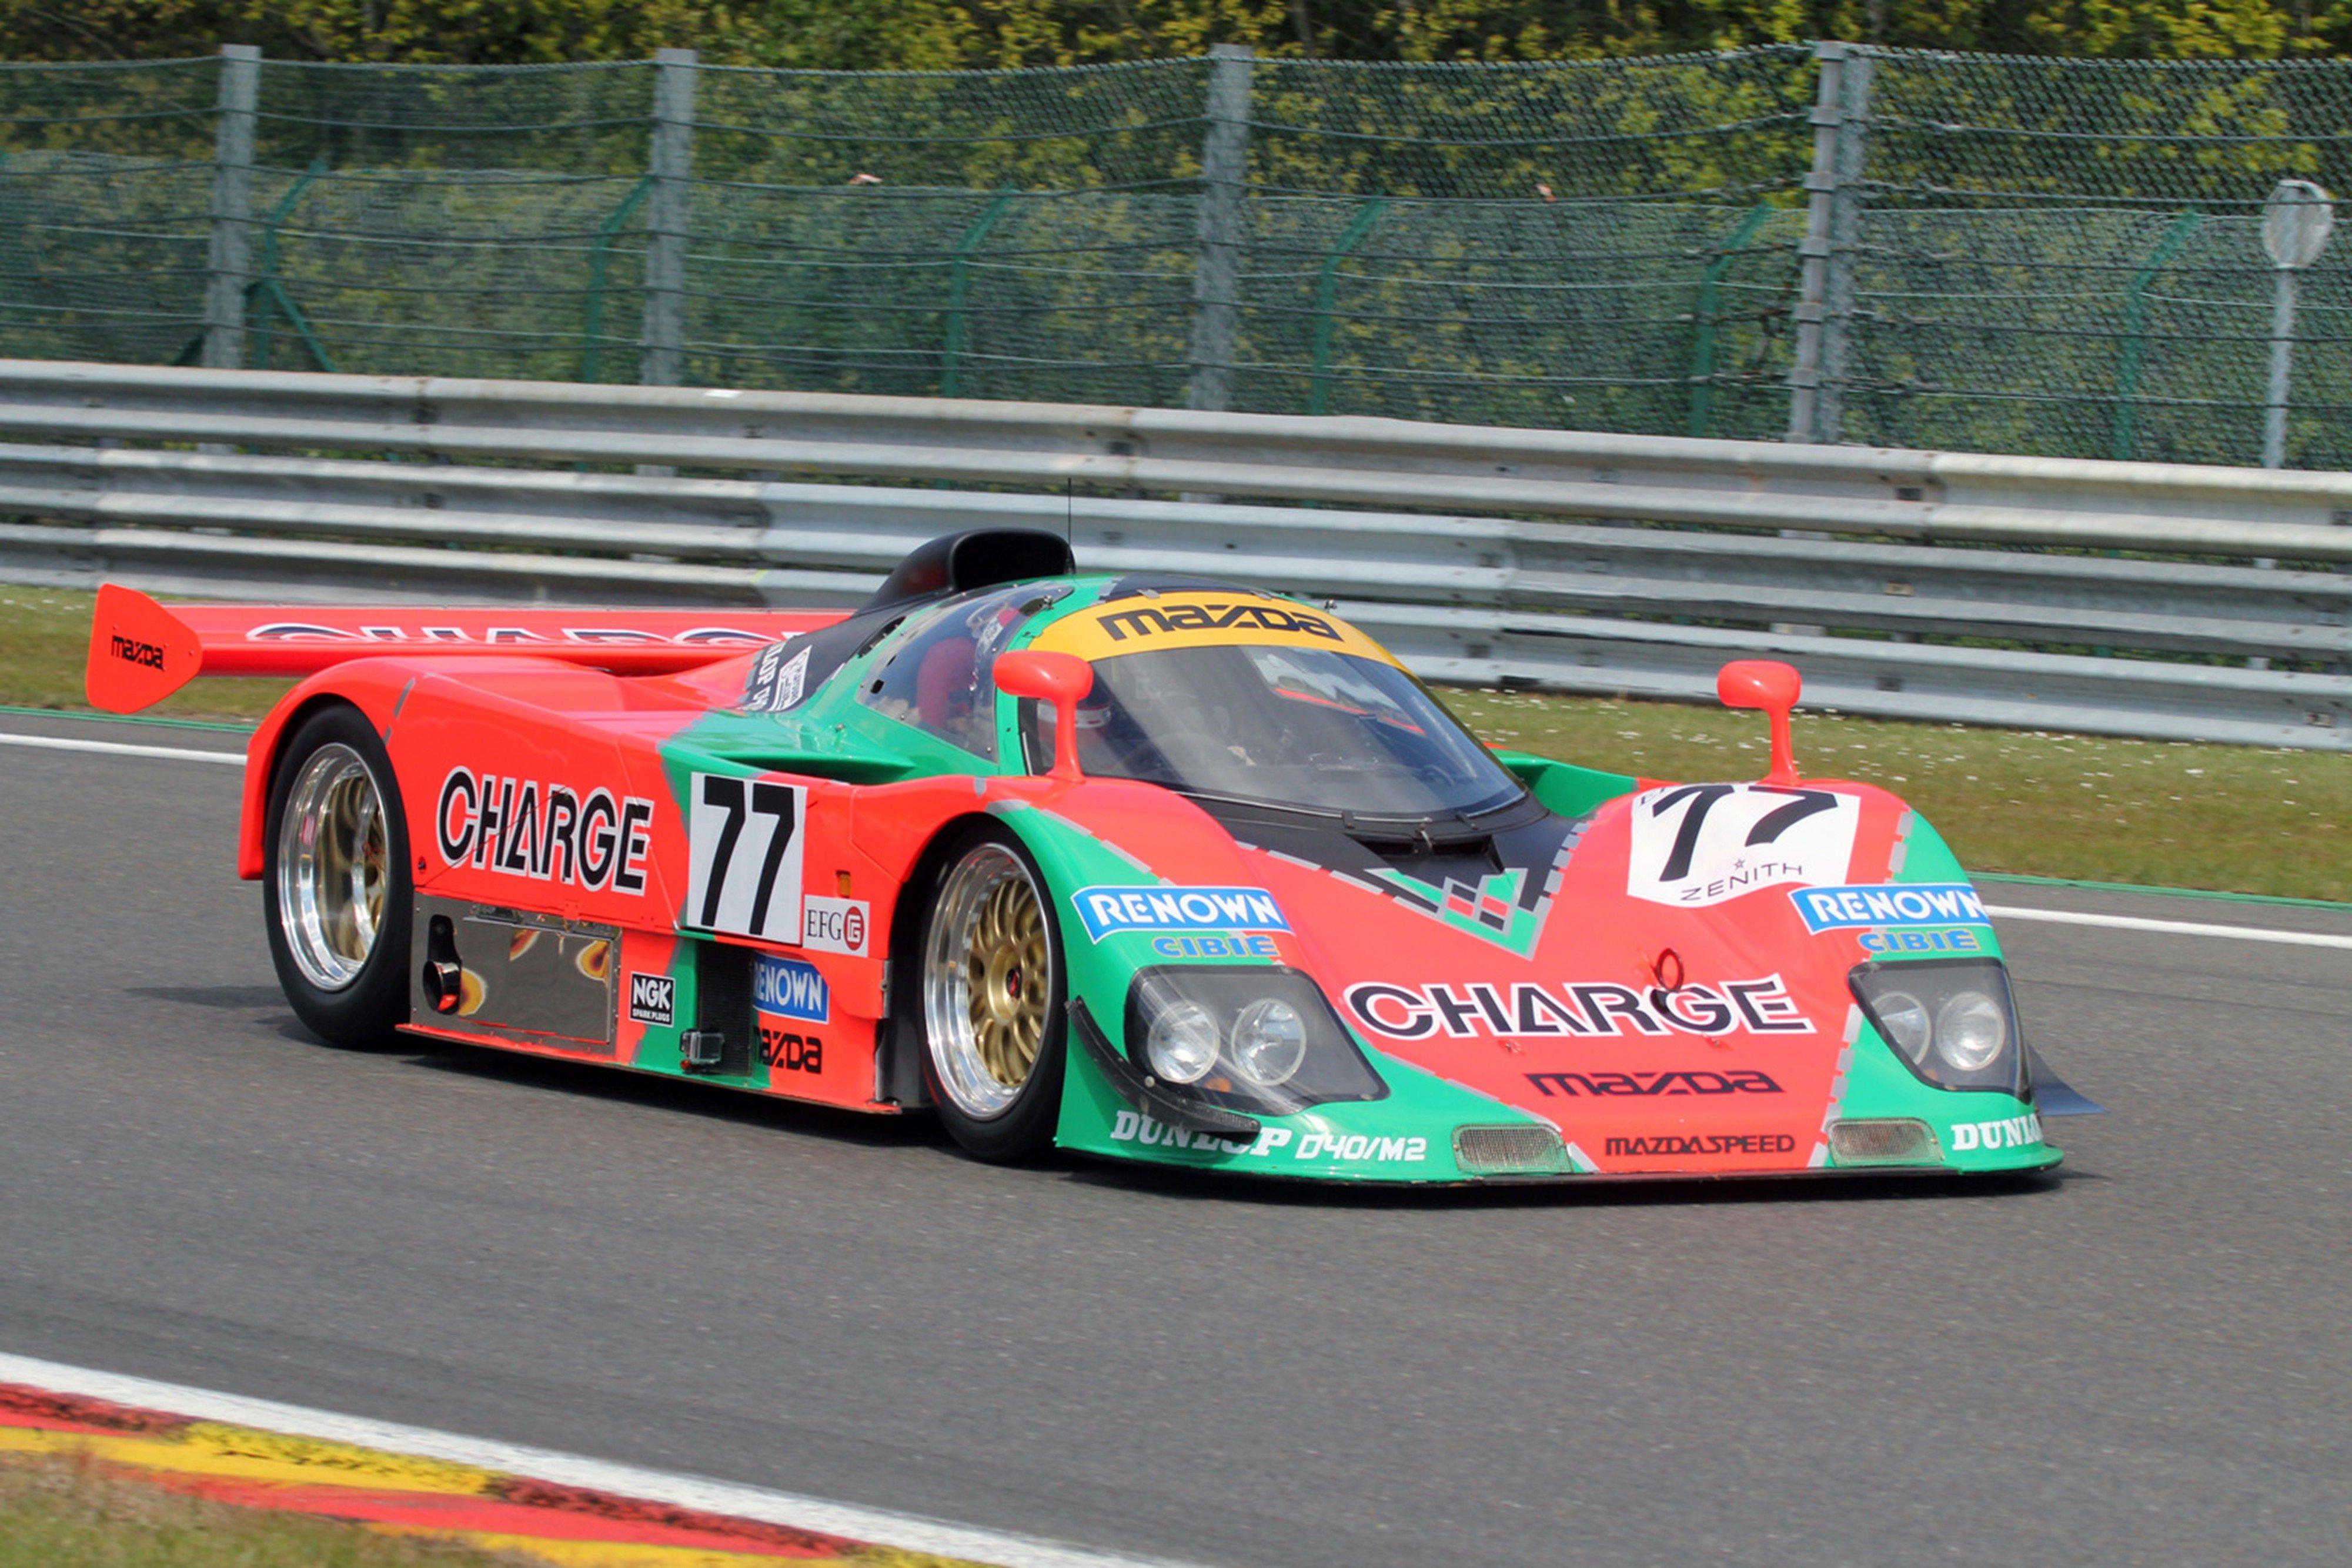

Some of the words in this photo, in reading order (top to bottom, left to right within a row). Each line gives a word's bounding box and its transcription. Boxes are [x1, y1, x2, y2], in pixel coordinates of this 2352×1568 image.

[436, 765, 654, 897] CHARGE
[1652, 785, 1838, 882] 77
[702, 775, 796, 935] 77
[1680, 862, 1803, 901] ZENITH
[807, 909, 842, 941] EFG
[1088, 893, 1284, 927] RENOWN
[1808, 890, 1986, 922] RENOWN
[633, 978, 671, 1011] NGK
[1343, 974, 1816, 1039] CHARGE
[759, 1027, 822, 1075] azda
[1605, 1134, 1795, 1156] MAZDASPEED
